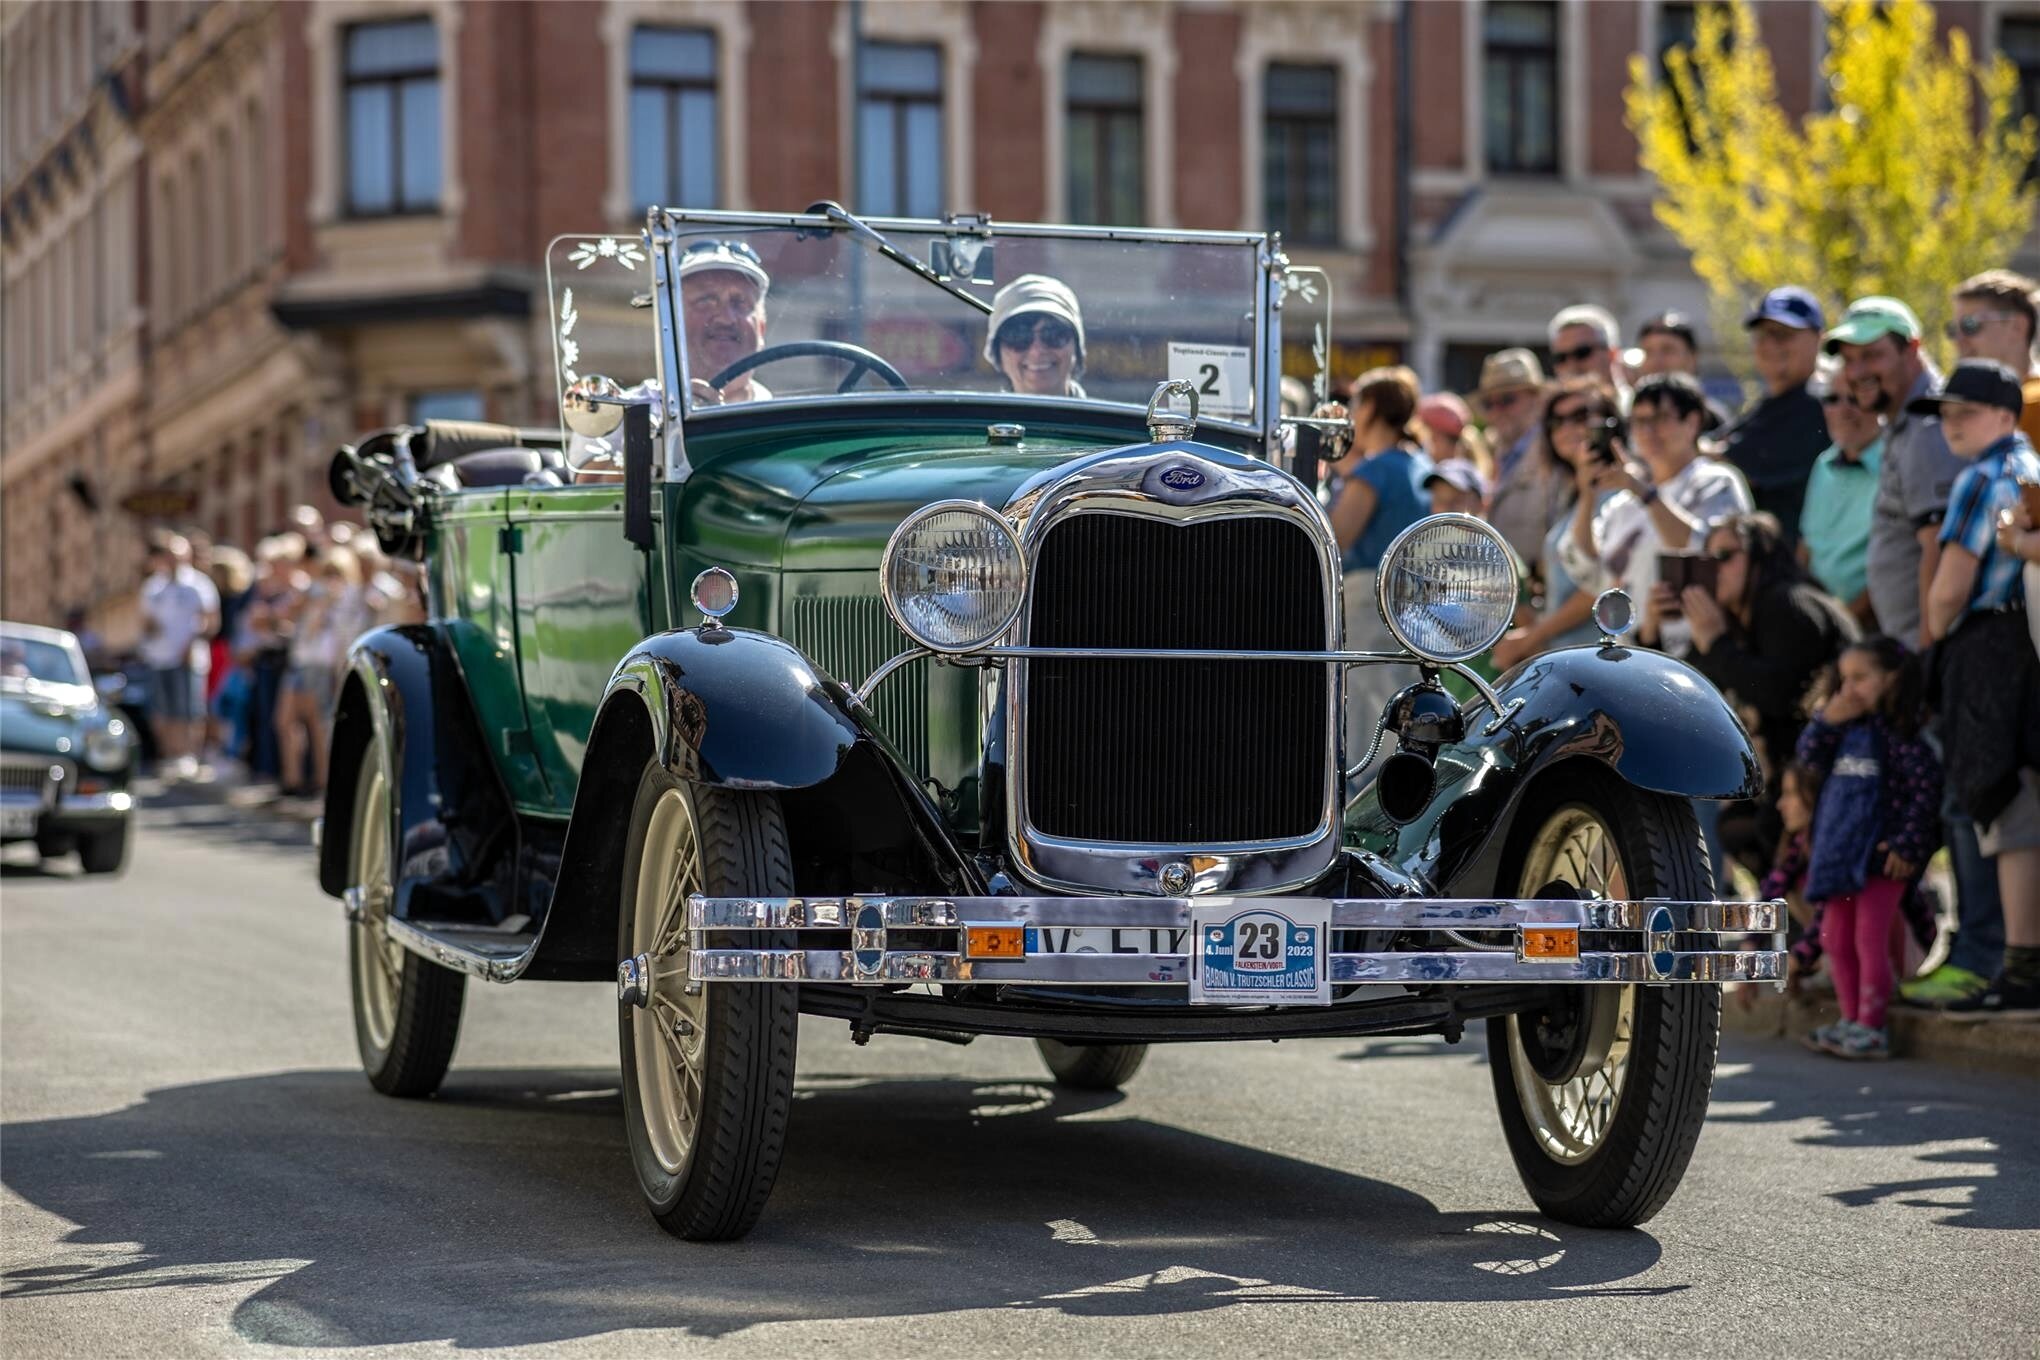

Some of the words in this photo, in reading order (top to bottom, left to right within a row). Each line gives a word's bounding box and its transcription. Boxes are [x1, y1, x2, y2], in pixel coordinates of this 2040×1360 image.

[1199, 364, 1220, 396] 2
[1165, 470, 1200, 485] Ford
[1205, 944, 1214, 956] 4.
[1214, 944, 1233, 956] Juni
[1239, 922, 1280, 959] 23
[1287, 945, 1313, 957] 2023
[1205, 965, 1229, 987] BARON
[1229, 973, 1236, 987] V.
[1286, 966, 1314, 988] CLASSIC
